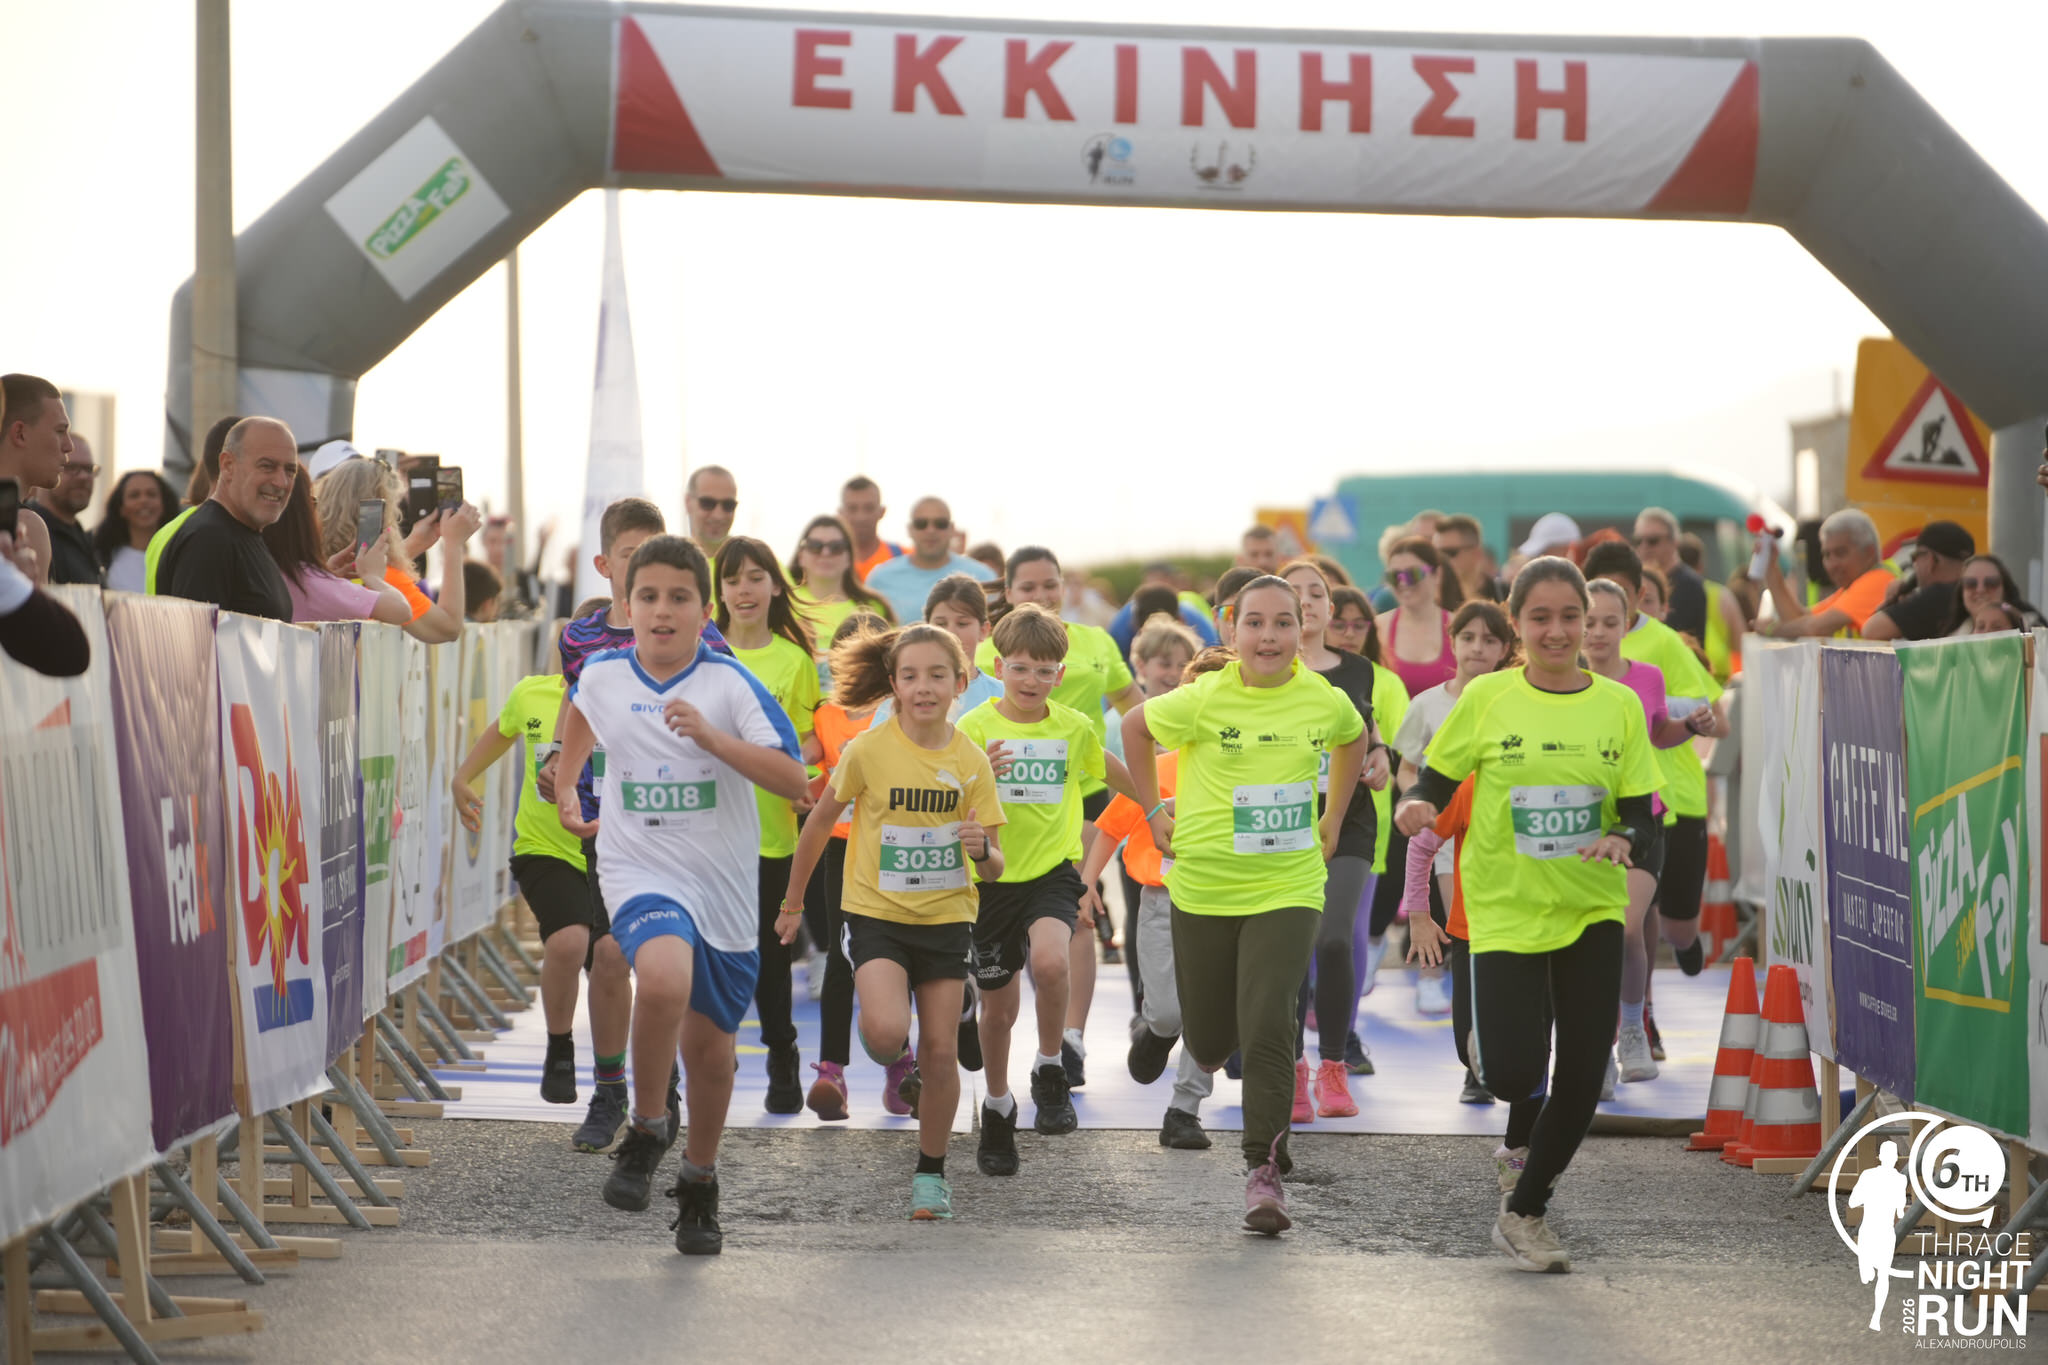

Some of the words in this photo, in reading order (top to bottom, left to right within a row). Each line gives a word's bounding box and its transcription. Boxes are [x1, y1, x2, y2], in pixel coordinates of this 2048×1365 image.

[791, 28, 1589, 143] ΕΚΚΙΝΗΣΗ
[631, 703, 665, 713] GIVO
[633, 785, 700, 810] 3018
[889, 787, 959, 813] PUMA
[1251, 805, 1304, 831] 3017
[1527, 809, 1591, 835] 3019
[893, 847, 956, 870] 3038
